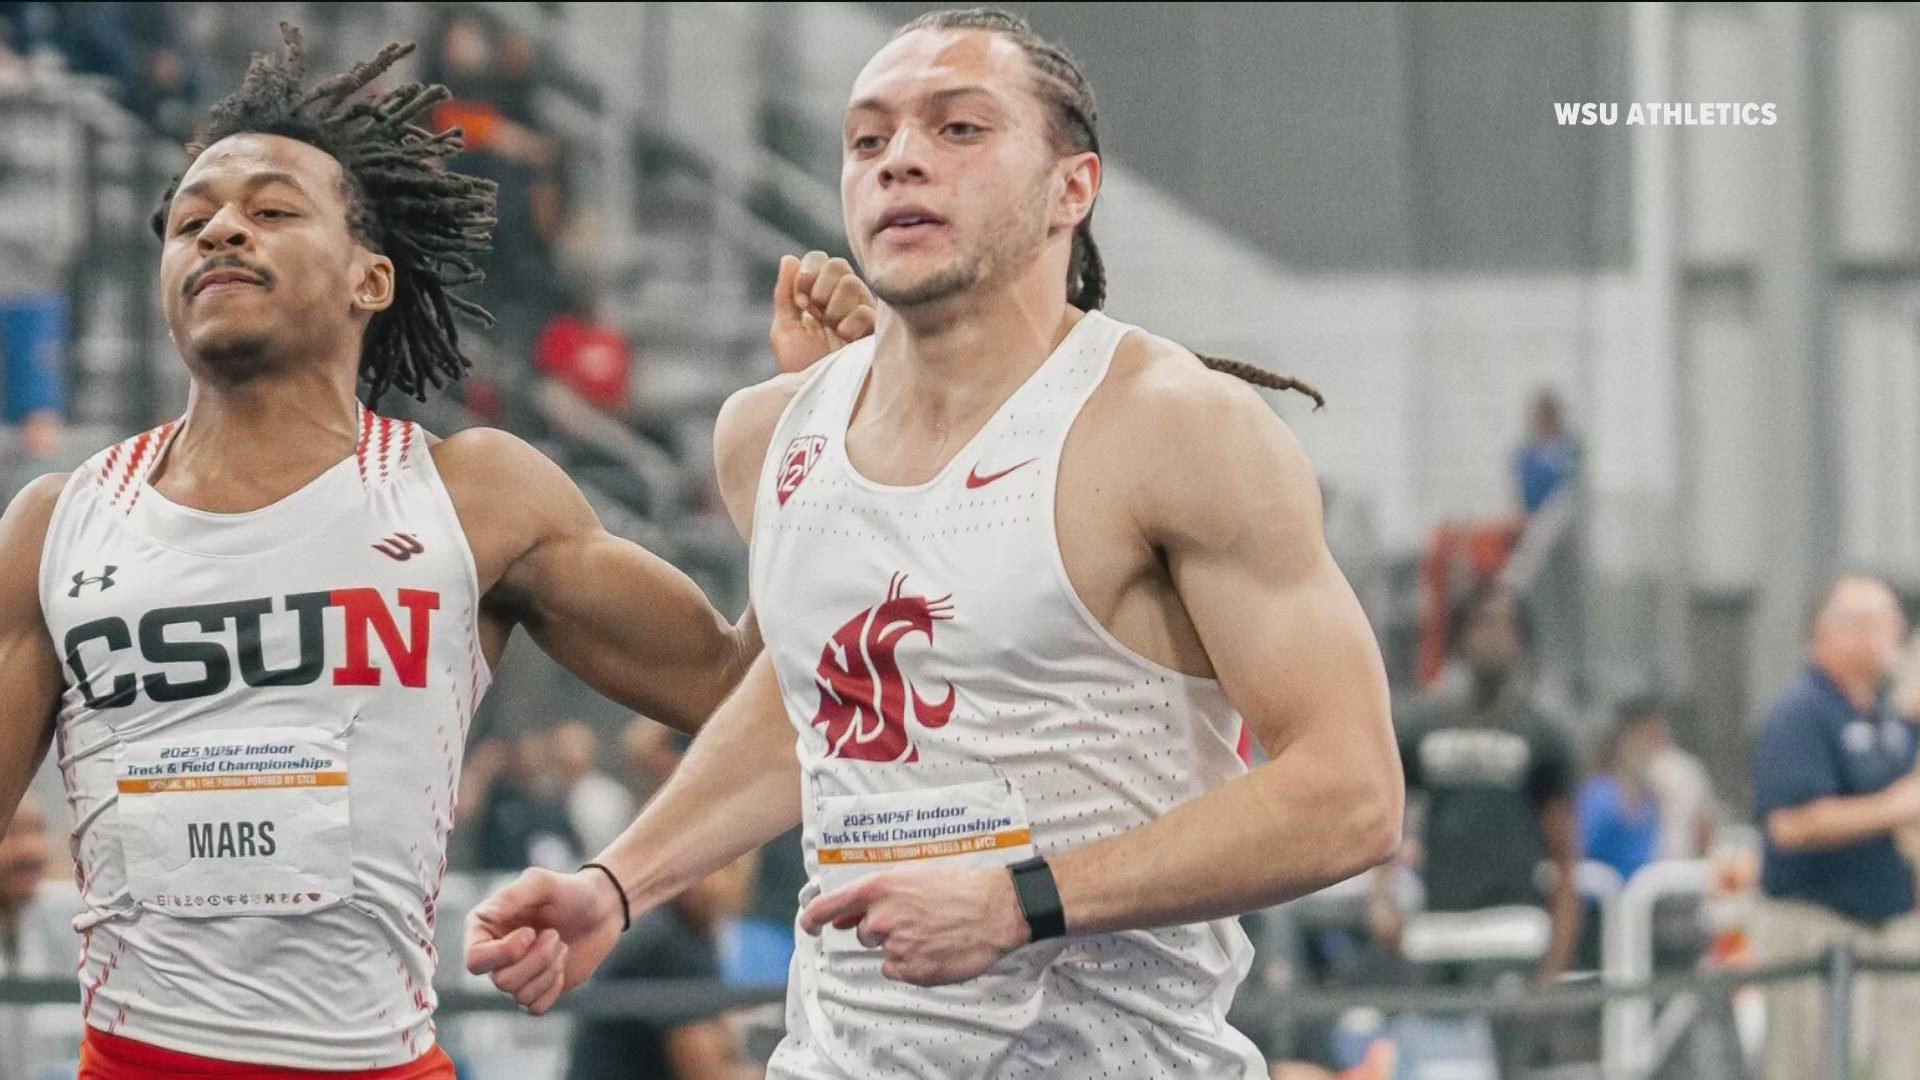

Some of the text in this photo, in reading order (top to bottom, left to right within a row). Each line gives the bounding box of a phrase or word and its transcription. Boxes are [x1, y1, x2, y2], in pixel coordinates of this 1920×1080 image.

[777, 464, 804, 492] 12
[63, 587, 441, 710] CSUN
[160, 746, 201, 759] 2025
[245, 743, 296, 755] Indoor
[128, 756, 333, 776] Track & Field Championships
[843, 805, 968, 827] 2025 MPSF Indoor
[187, 820, 277, 858] MARS
[823, 817, 1012, 845] Track & Field Championships
